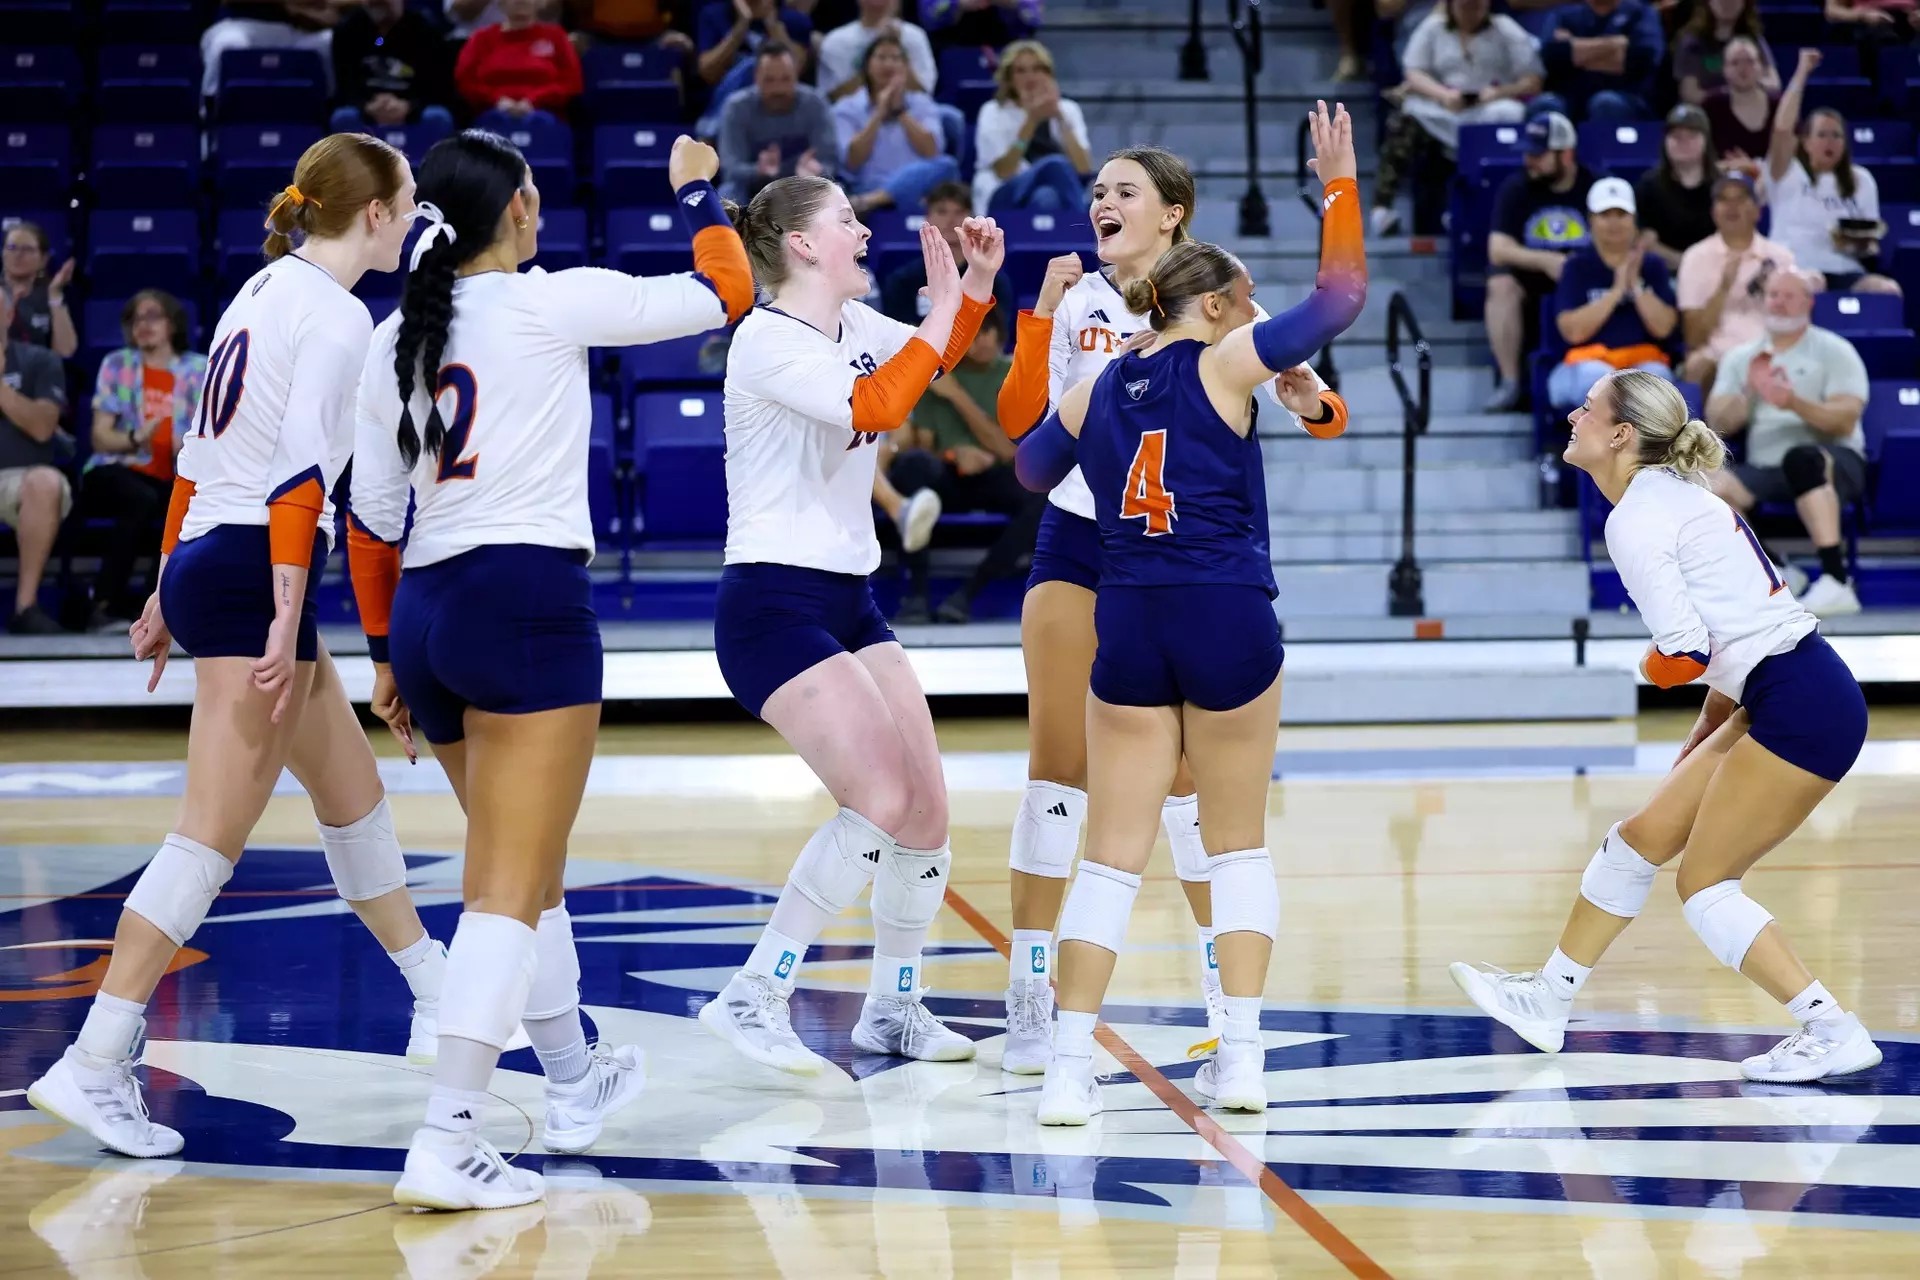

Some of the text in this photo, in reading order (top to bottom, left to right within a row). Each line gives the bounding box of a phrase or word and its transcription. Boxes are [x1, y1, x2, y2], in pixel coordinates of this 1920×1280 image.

[198, 327, 250, 440] 10
[1079, 327, 1115, 353] UT
[435, 363, 479, 484] 2
[1119, 428, 1178, 537] 4
